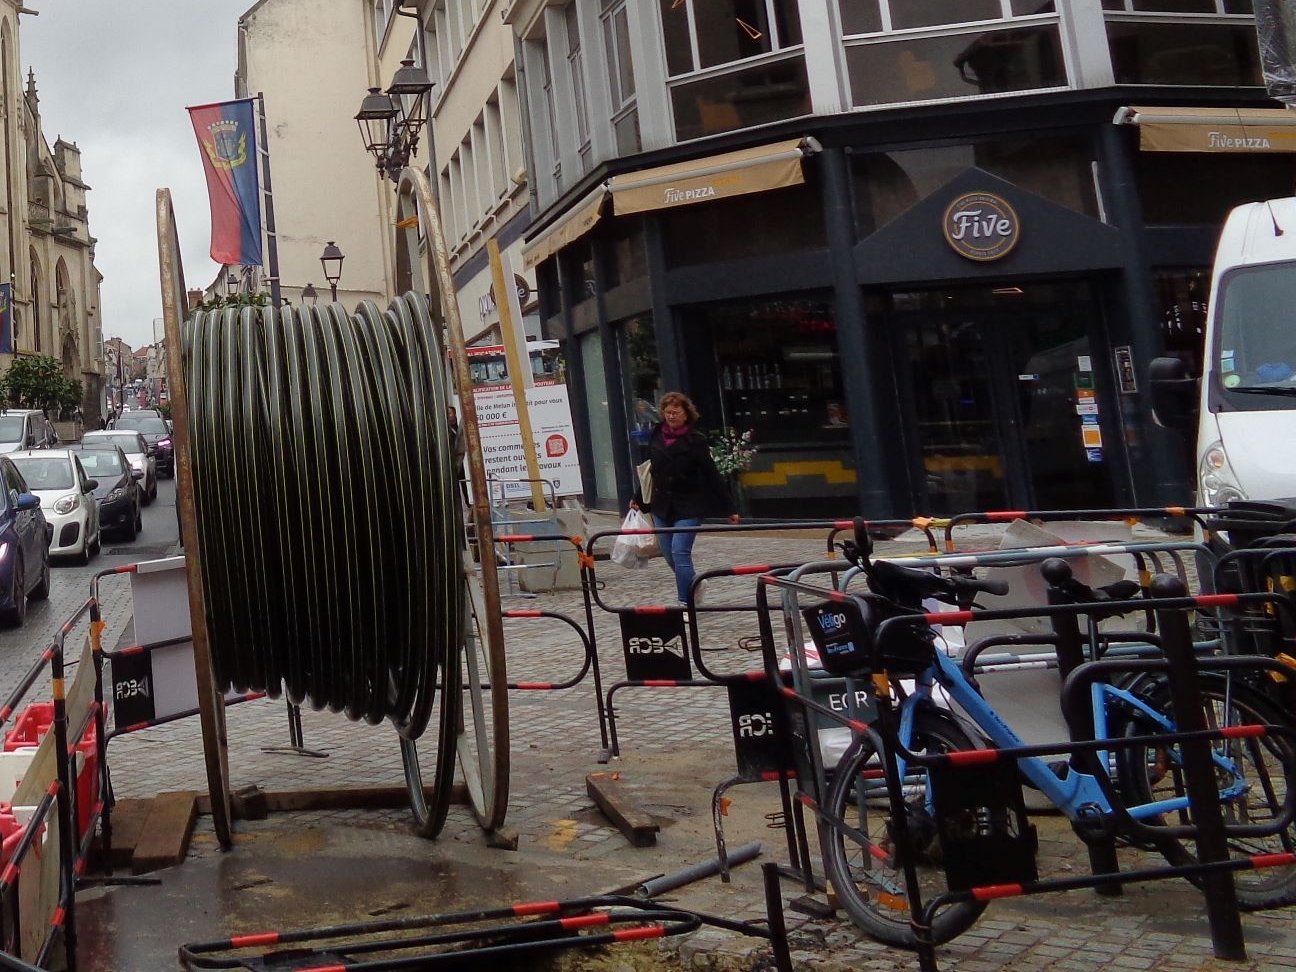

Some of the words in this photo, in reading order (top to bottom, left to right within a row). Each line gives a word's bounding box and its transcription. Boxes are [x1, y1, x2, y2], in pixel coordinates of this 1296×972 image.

[1208, 131, 1233, 149] Five
[1234, 138, 1271, 149] PIZZA
[663, 187, 685, 205] Five
[685, 186, 716, 200] PIZZA
[951, 209, 1012, 240] Five
[485, 456, 512, 464] restent
[817, 613, 846, 629] Véligo
